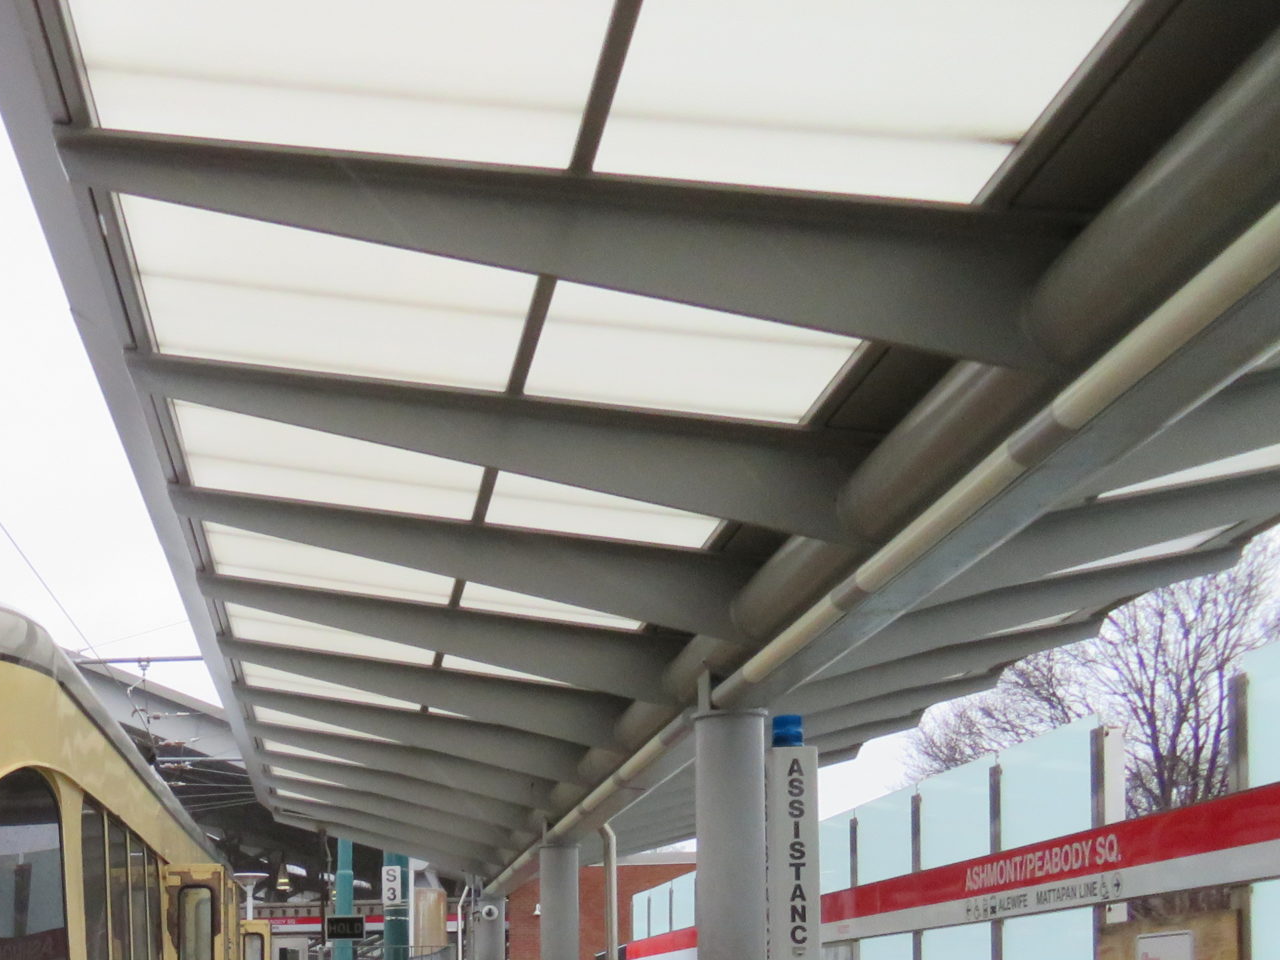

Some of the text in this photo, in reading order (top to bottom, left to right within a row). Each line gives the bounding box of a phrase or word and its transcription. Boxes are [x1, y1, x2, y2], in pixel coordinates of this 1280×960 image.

[965, 833, 1122, 893] ASHMONT/PEABODY SQ.
[998, 893, 1028, 911] ALEWIFE
[1036, 881, 1098, 905] MATTAPAN LINE
[328, 921, 363, 934] HOLD
